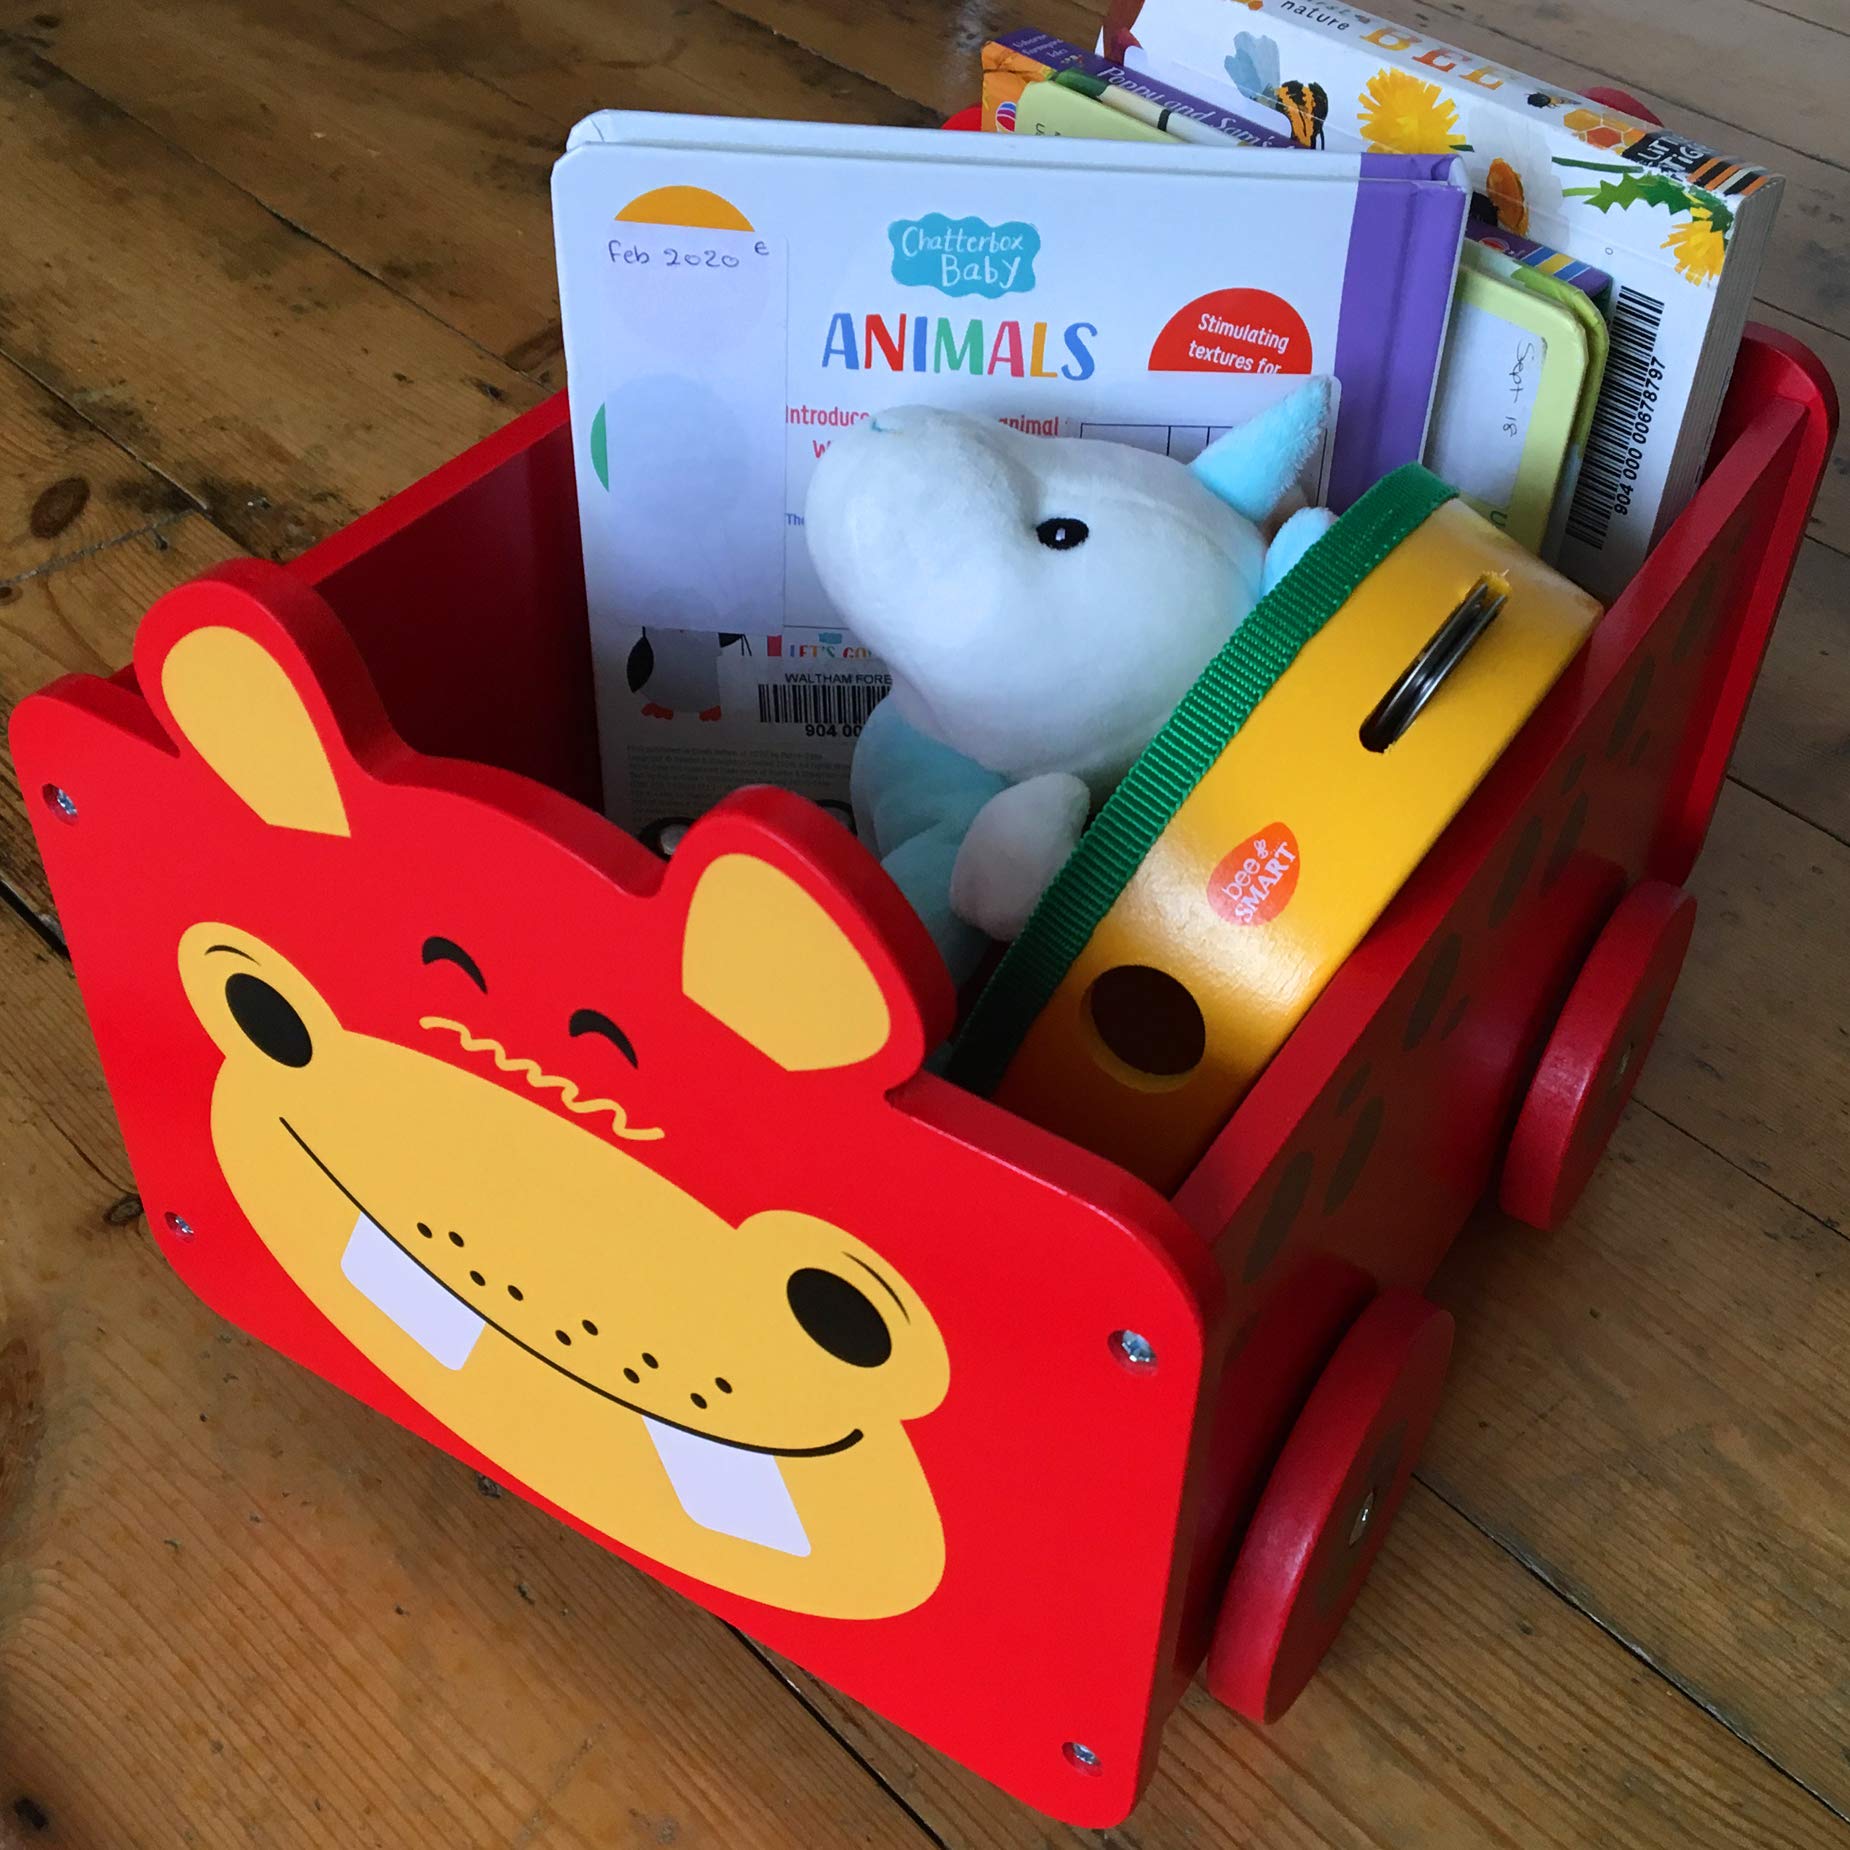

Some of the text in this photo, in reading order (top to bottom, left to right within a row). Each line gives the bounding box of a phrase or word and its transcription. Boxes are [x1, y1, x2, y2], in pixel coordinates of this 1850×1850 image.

[1280, 0, 1350, 31] nature
[1163, 100, 1216, 121] and
[608, 239, 650, 264] Feb
[663, 248, 740, 268] 2020
[902, 226, 1024, 257] Chatterbox
[941, 254, 1021, 288] Baby
[822, 312, 1098, 381] ANIMALS
[1198, 313, 1290, 354] Stimulating
[1188, 340, 1282, 374] textures for
[1614, 355, 1666, 516] 904 000 00678797
[785, 673, 852, 685] WALTHAM
[805, 724, 838, 738] 904
[1221, 857, 1261, 901] bee
[1234, 841, 1297, 923] SMART
